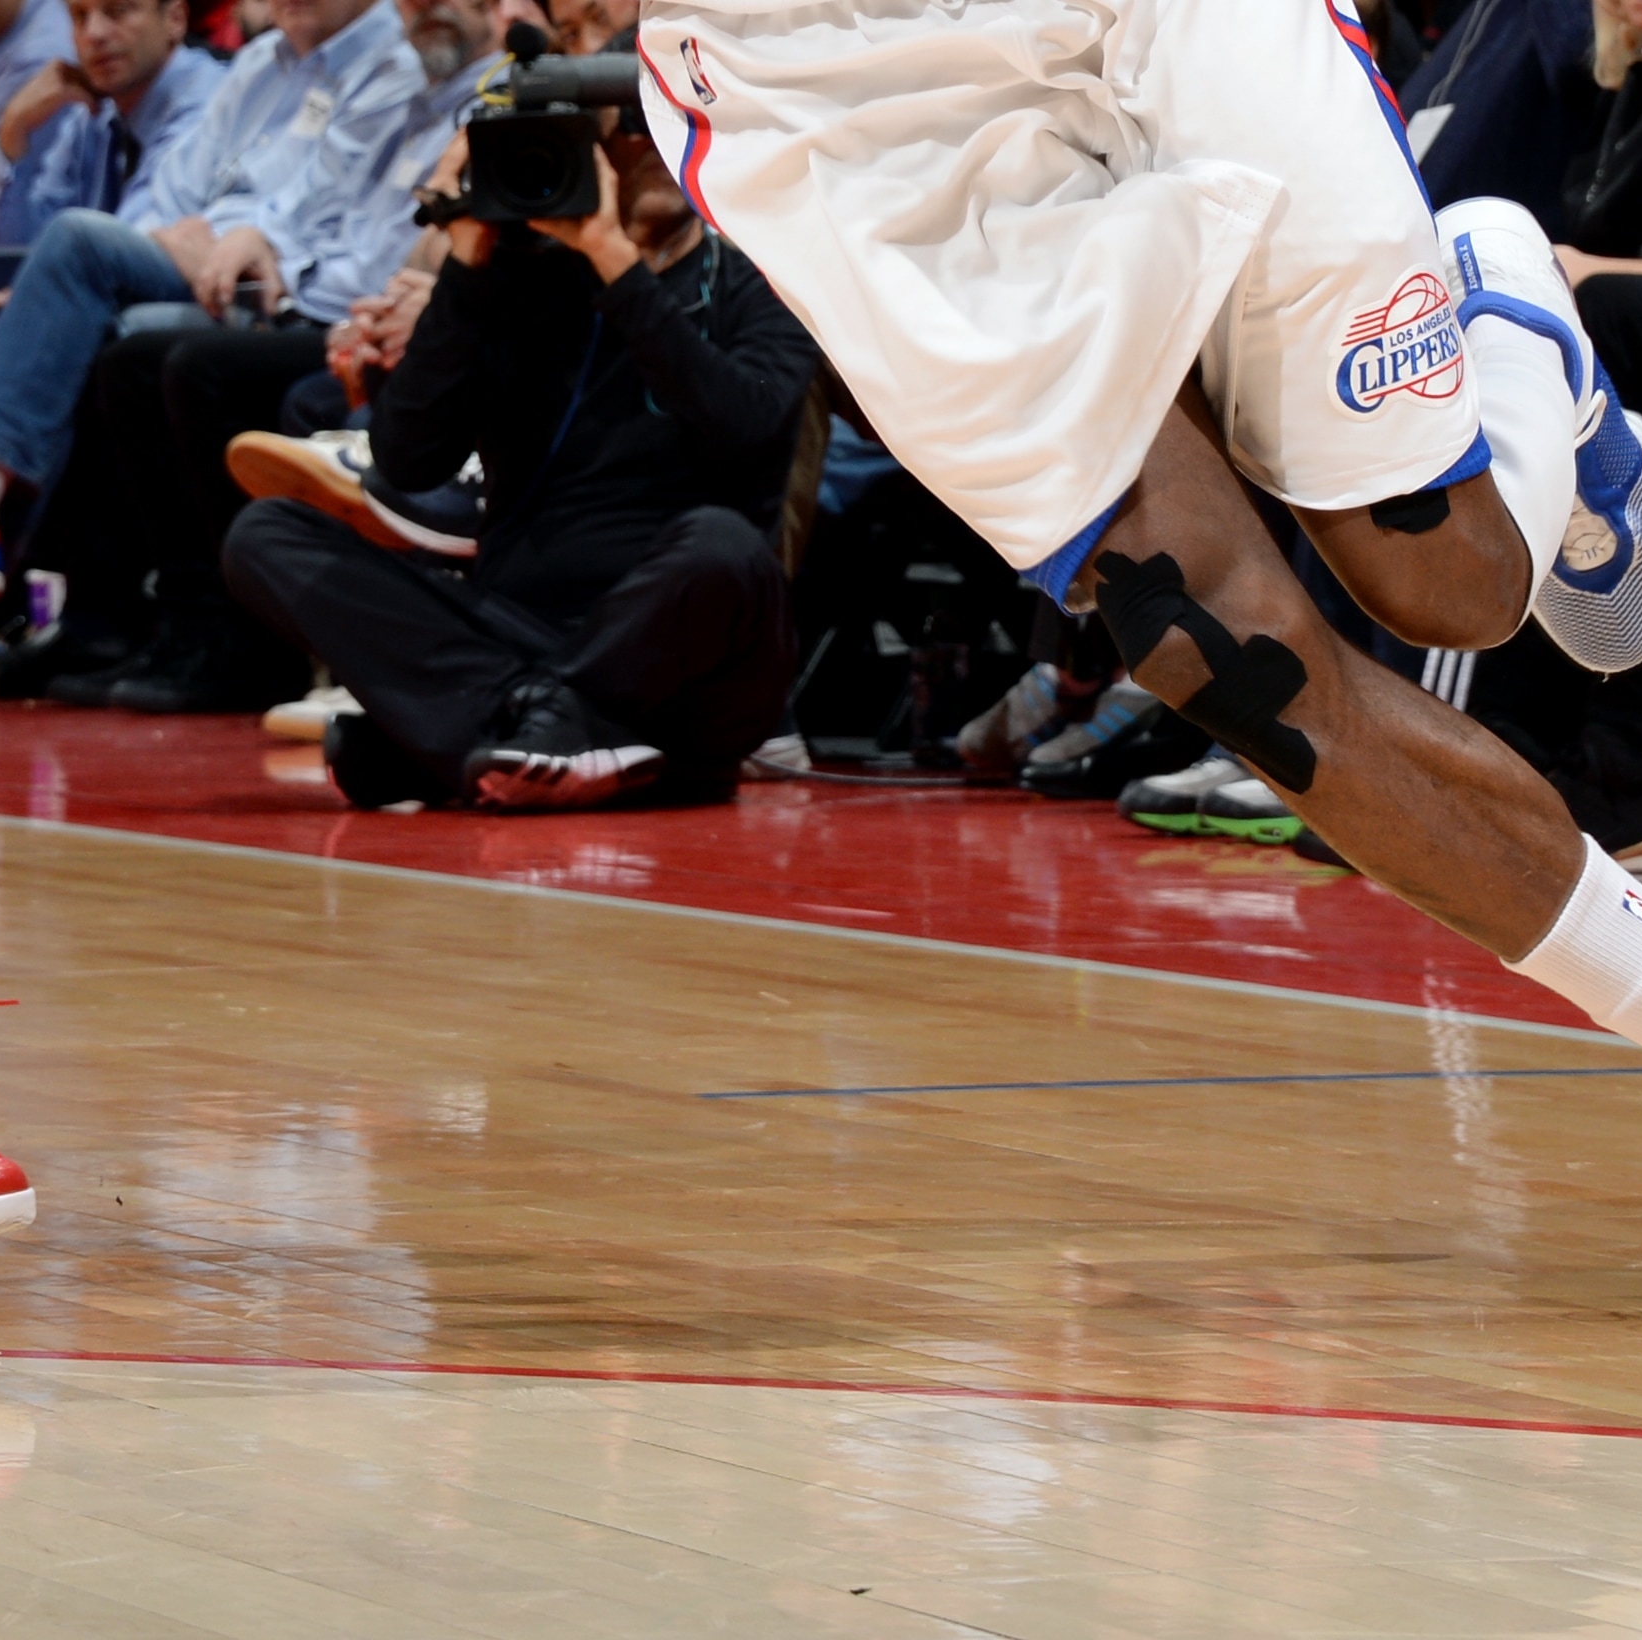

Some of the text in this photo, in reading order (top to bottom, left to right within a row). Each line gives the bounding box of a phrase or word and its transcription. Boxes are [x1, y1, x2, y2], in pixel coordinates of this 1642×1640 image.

[1390, 306, 1452, 348] LOS ANGELES
[1336, 322, 1458, 414] CLIPPERS
